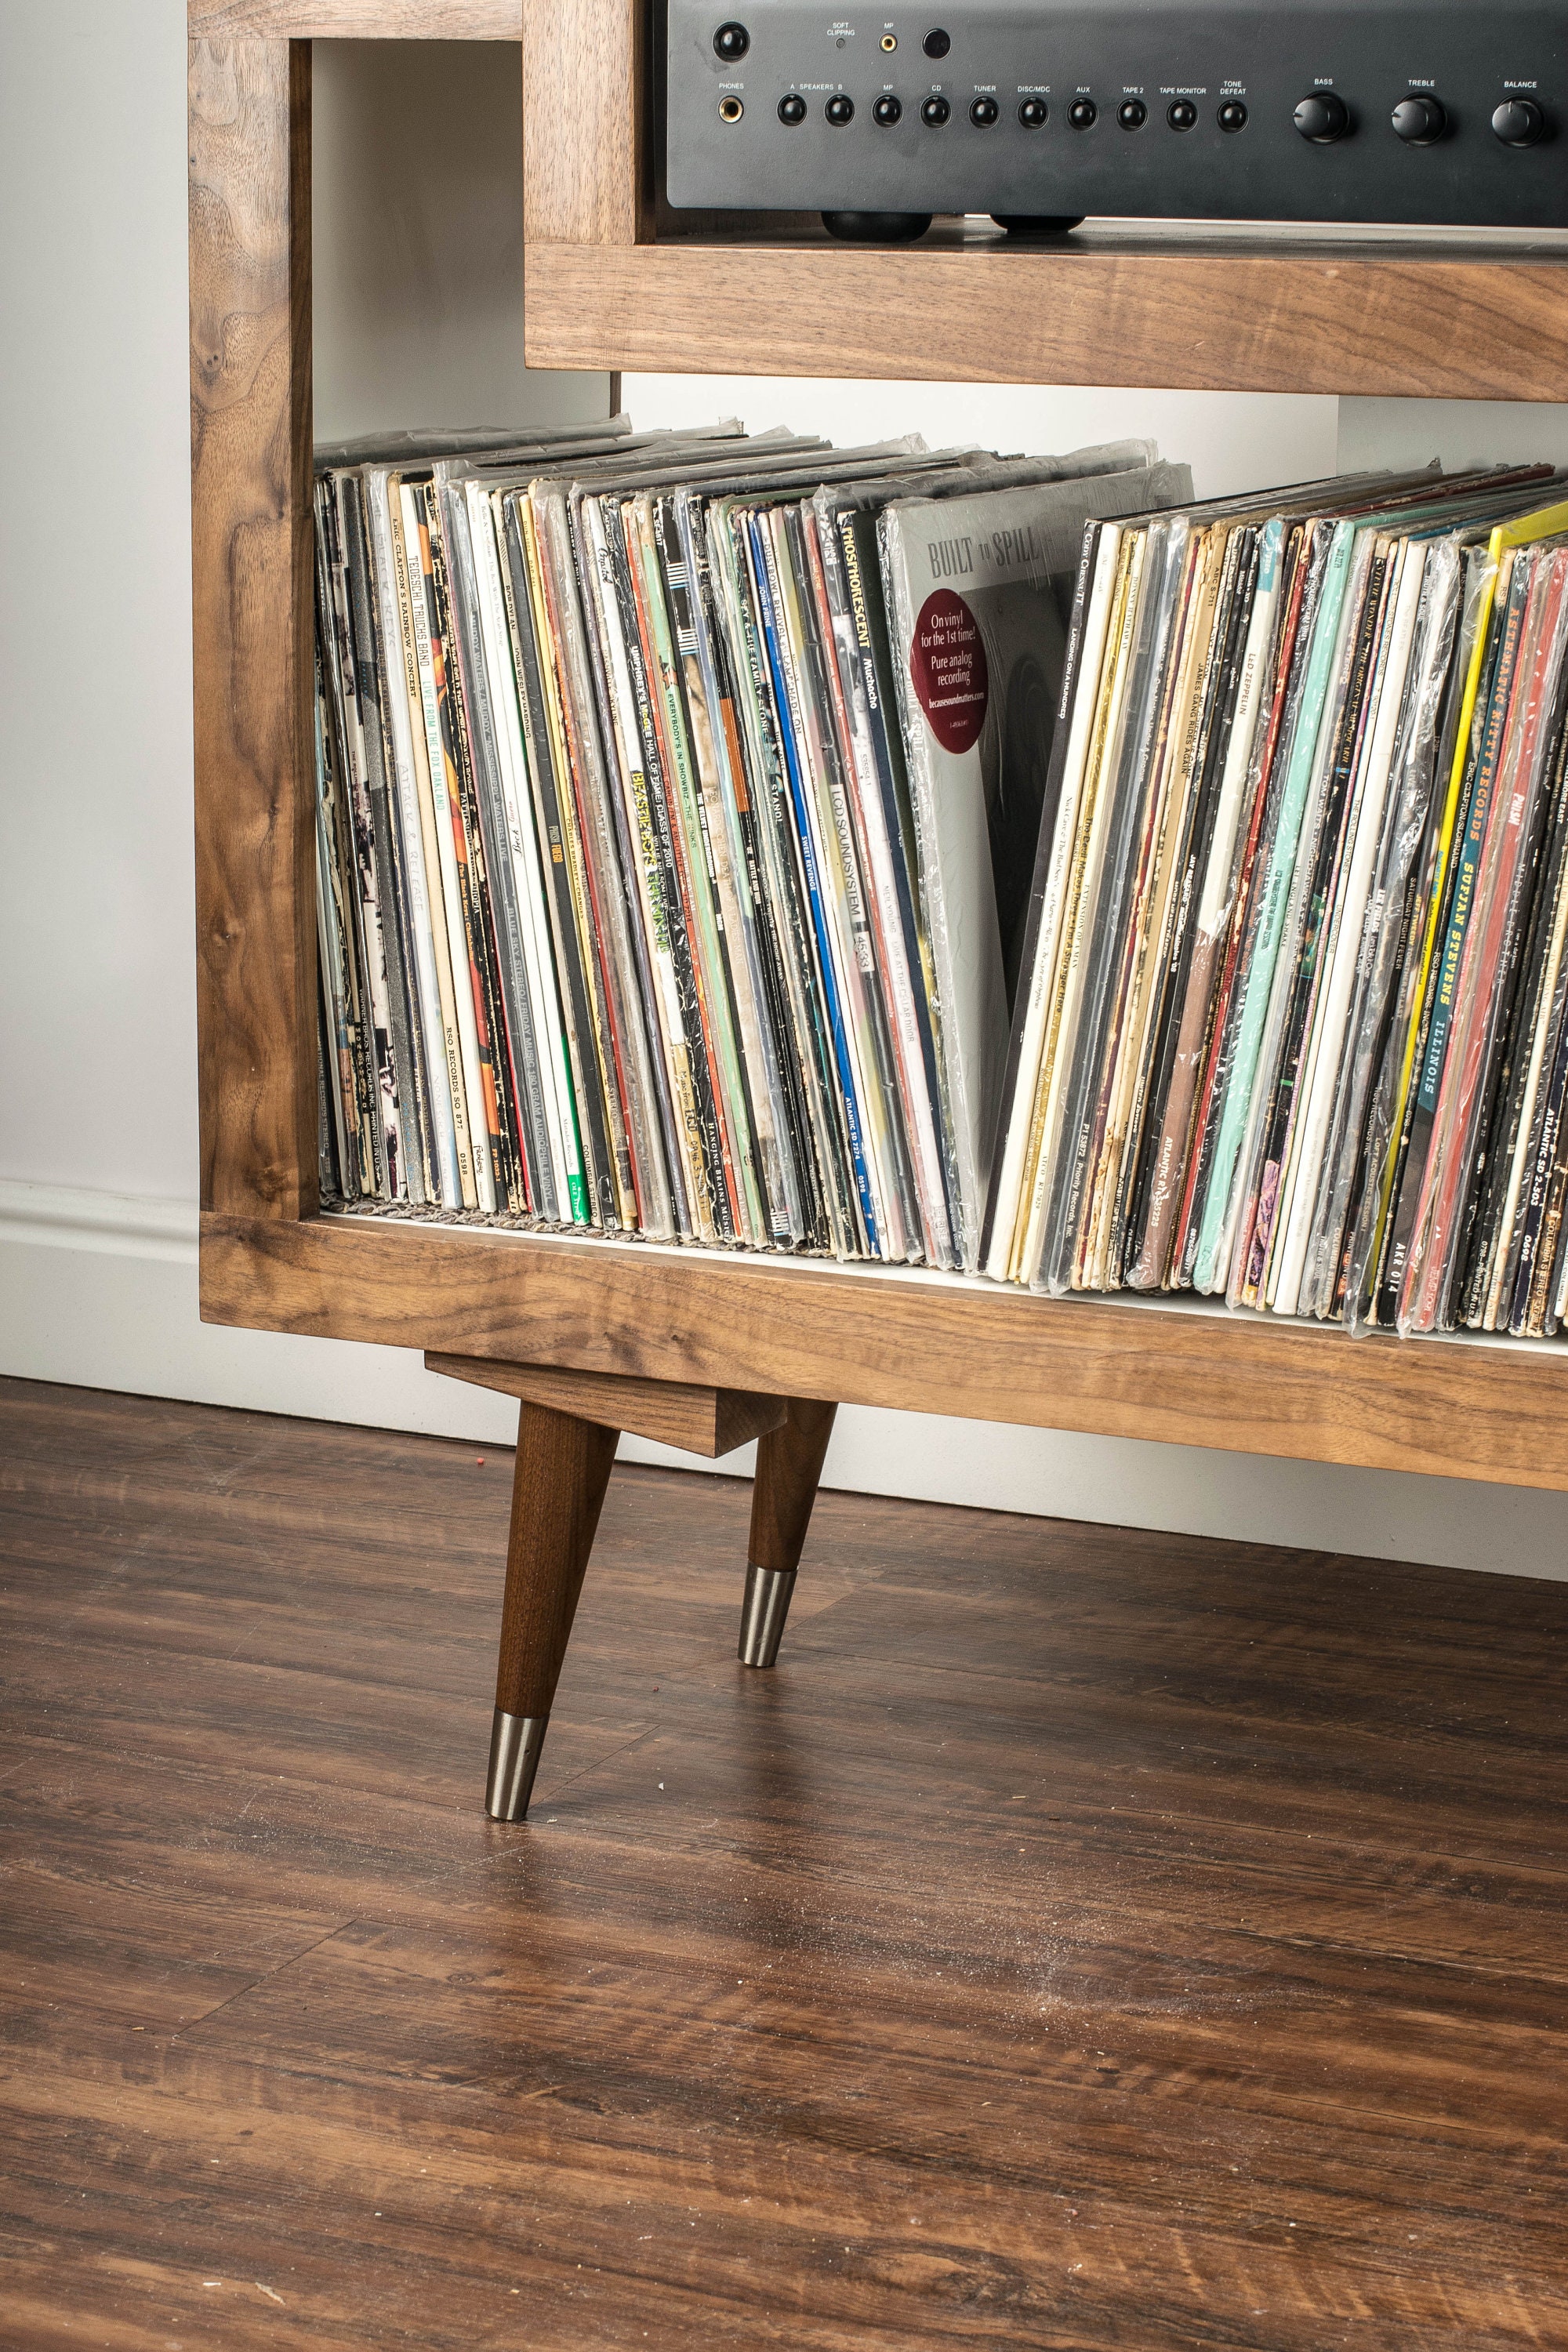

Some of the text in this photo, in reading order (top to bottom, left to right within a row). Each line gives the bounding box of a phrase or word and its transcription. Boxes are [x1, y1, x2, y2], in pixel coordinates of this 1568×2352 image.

[394, 544, 406, 598] CLAPTONS
[595, 546, 614, 585] Capitol
[928, 536, 974, 579] BUILT
[992, 527, 1039, 567] SPILL
[757, 585, 771, 628] JOHN PRINE
[842, 527, 871, 649] PHOSPHORESCENT
[401, 601, 411, 648] RAINBOW
[407, 555, 430, 666] TEDESCHI TRUCKS BAND
[931, 609, 964, 630] On vinyl
[468, 615, 480, 649] MUDDY
[921, 627, 976, 648] for the 1st time!
[1066, 627, 1078, 662] LANDING
[405, 652, 416, 698] CONCERT
[474, 651, 485, 690] WATERS
[630, 645, 646, 702] UMPHREY'S
[931, 651, 972, 670] Pure analog
[938, 668, 971, 686] recording
[1065, 662, 1073, 674] ON
[862, 657, 877, 709] Muchacho
[929, 691, 984, 709] becausesoundmatters.com
[1058, 682, 1069, 719] HUNDRED
[1238, 652, 1257, 715] LED ZEPPELIN
[480, 699, 491, 733] MUDDY
[668, 694, 681, 749] EVERYBODY'S
[676, 751, 683, 760] IN
[1180, 662, 1204, 775] JAMES GANG RIDES AGAIN
[1471, 608, 1519, 842] ASTHMATIC KITTY RECORDS
[422, 680, 445, 811] LIVE FROM THE FOX OAKLAND
[644, 739, 656, 762] HALL
[648, 762, 658, 775] OF
[1465, 760, 1475, 782] ERIC
[493, 800, 506, 840] WATERS
[631, 771, 657, 867] BEASTIE BOYS
[655, 804, 667, 833] CLASS
[1312, 773, 1329, 829] TOM WAITS
[1508, 793, 1526, 826] PHISH
[499, 841, 508, 862] LIVE
[546, 824, 564, 864] PHISH FUEGO
[660, 833, 669, 847] OF
[695, 792, 715, 877] THE VELVET UNDERGROUND
[830, 789, 859, 916] LCD SOUNDSYSTEM
[565, 817, 584, 919] CHARLES BRADLEY CHANGES
[662, 848, 673, 868] 2010
[800, 835, 817, 891] SWEET REVENGE
[461, 899, 470, 916] Keys
[1455, 862, 1474, 925] SUFJAN
[465, 921, 474, 960] Chulahoma
[714, 913, 724, 931] MGM
[1328, 904, 1342, 953] UNDERCOVER
[1394, 877, 1417, 970] SATURDAY NIGHT FEVER
[855, 935, 869, 968] 45:33
[1439, 930, 1462, 1005] STEVENS
[448, 1049, 459, 1092] RECORDS
[506, 907, 553, 1201] BLUE SKY STEREO/ FRIDAY MUSIC 180 GRAM AUDIOPHILE VINYL
[1424, 1022, 1444, 1094] ILLINOIS
[453, 1097, 460, 1109] SO
[844, 1096, 861, 1160] ATLANTIC SD 7274
[459, 1152, 467, 1175] 0598
[492, 1148, 498, 1158] FP
[1529, 1107, 1555, 1207] ATLANTIC SD 2-503
[857, 1174, 866, 1193] 0598
[1064, 1123, 1089, 1239] P1 53872 Priority Records, Inc.
[1387, 1242, 1406, 1293] AKR 014
[1519, 1234, 1533, 1261] 0698
